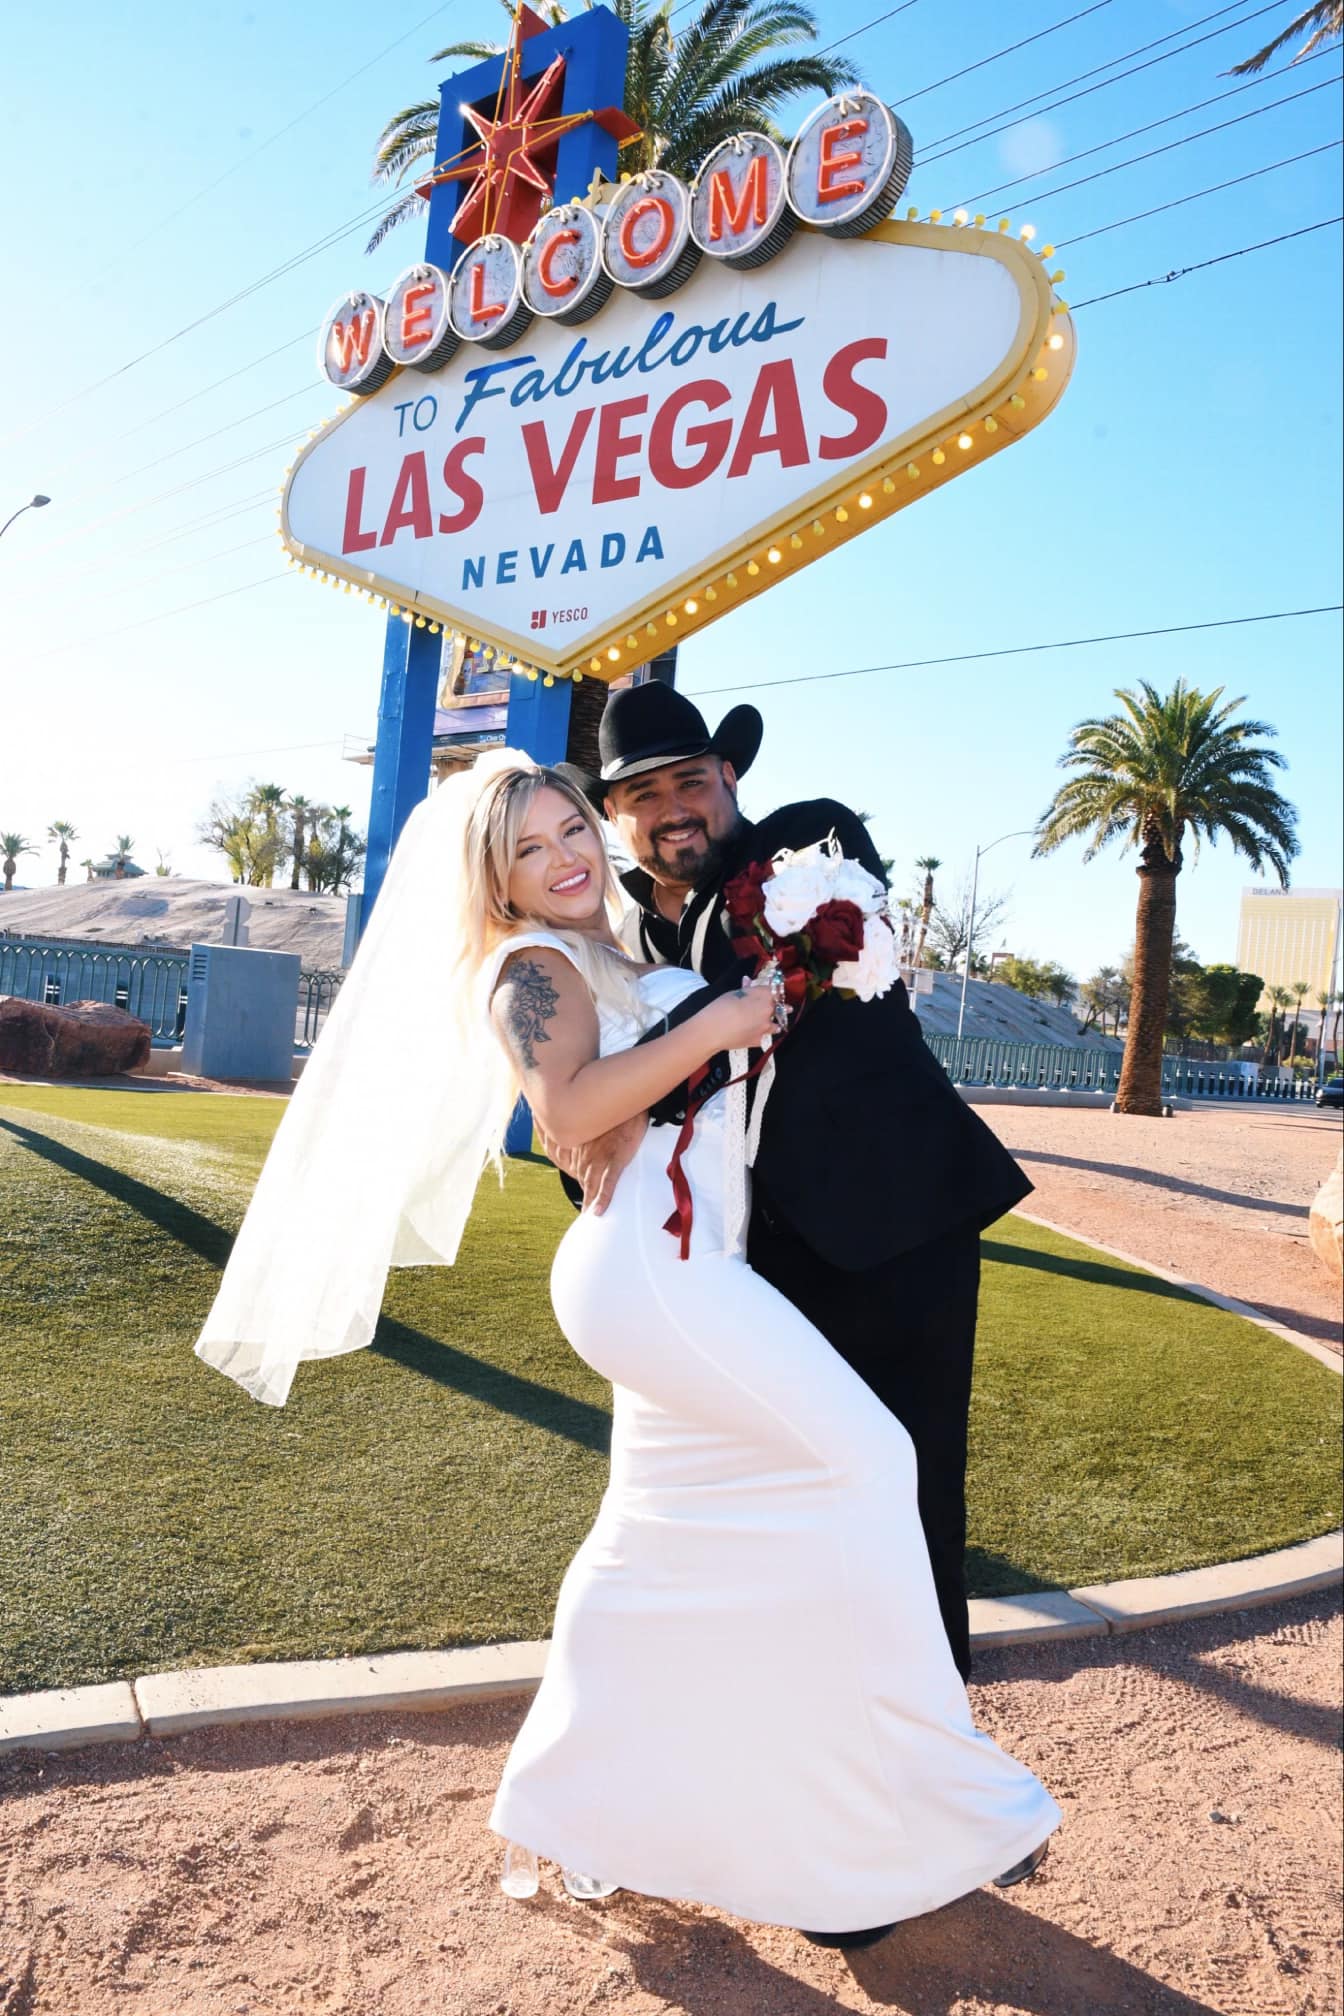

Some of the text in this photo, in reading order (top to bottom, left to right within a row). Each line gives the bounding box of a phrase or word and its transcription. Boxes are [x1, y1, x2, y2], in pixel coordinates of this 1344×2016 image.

[333, 119, 869, 374] WELCOME
[394, 302, 805, 436] TO Fabulous
[342, 337, 888, 555] LAS VEGAS
[461, 525, 664, 590] NEVADA
[552, 607, 588, 624] YESCO
